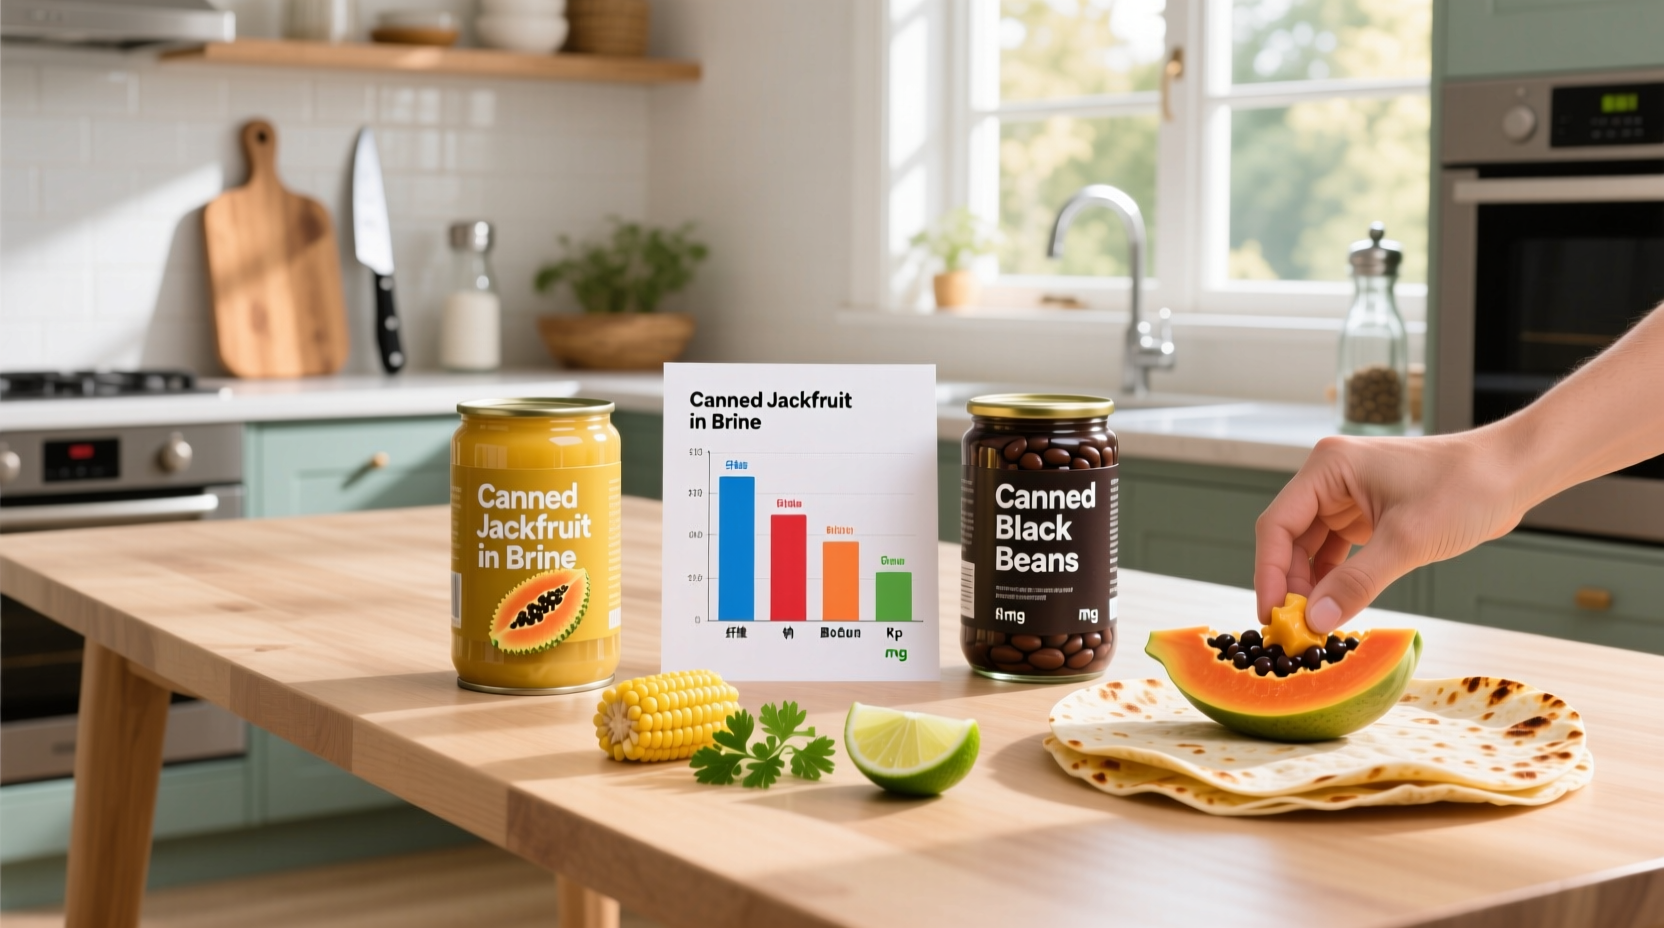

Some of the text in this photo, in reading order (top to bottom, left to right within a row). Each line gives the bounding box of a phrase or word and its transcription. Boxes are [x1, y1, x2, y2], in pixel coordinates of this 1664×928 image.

[689, 391, 853, 409] Canned Jackfruit
[689, 413, 762, 430] in Brine
[477, 482, 578, 510] Canned
[995, 481, 1096, 510] Canned
[476, 513, 592, 540] Jackfruit
[995, 513, 1073, 542] Black
[478, 542, 577, 570] in Brine
[995, 545, 1079, 573] Beans
[1078, 608, 1099, 624] mg
[885, 648, 908, 662] mg
